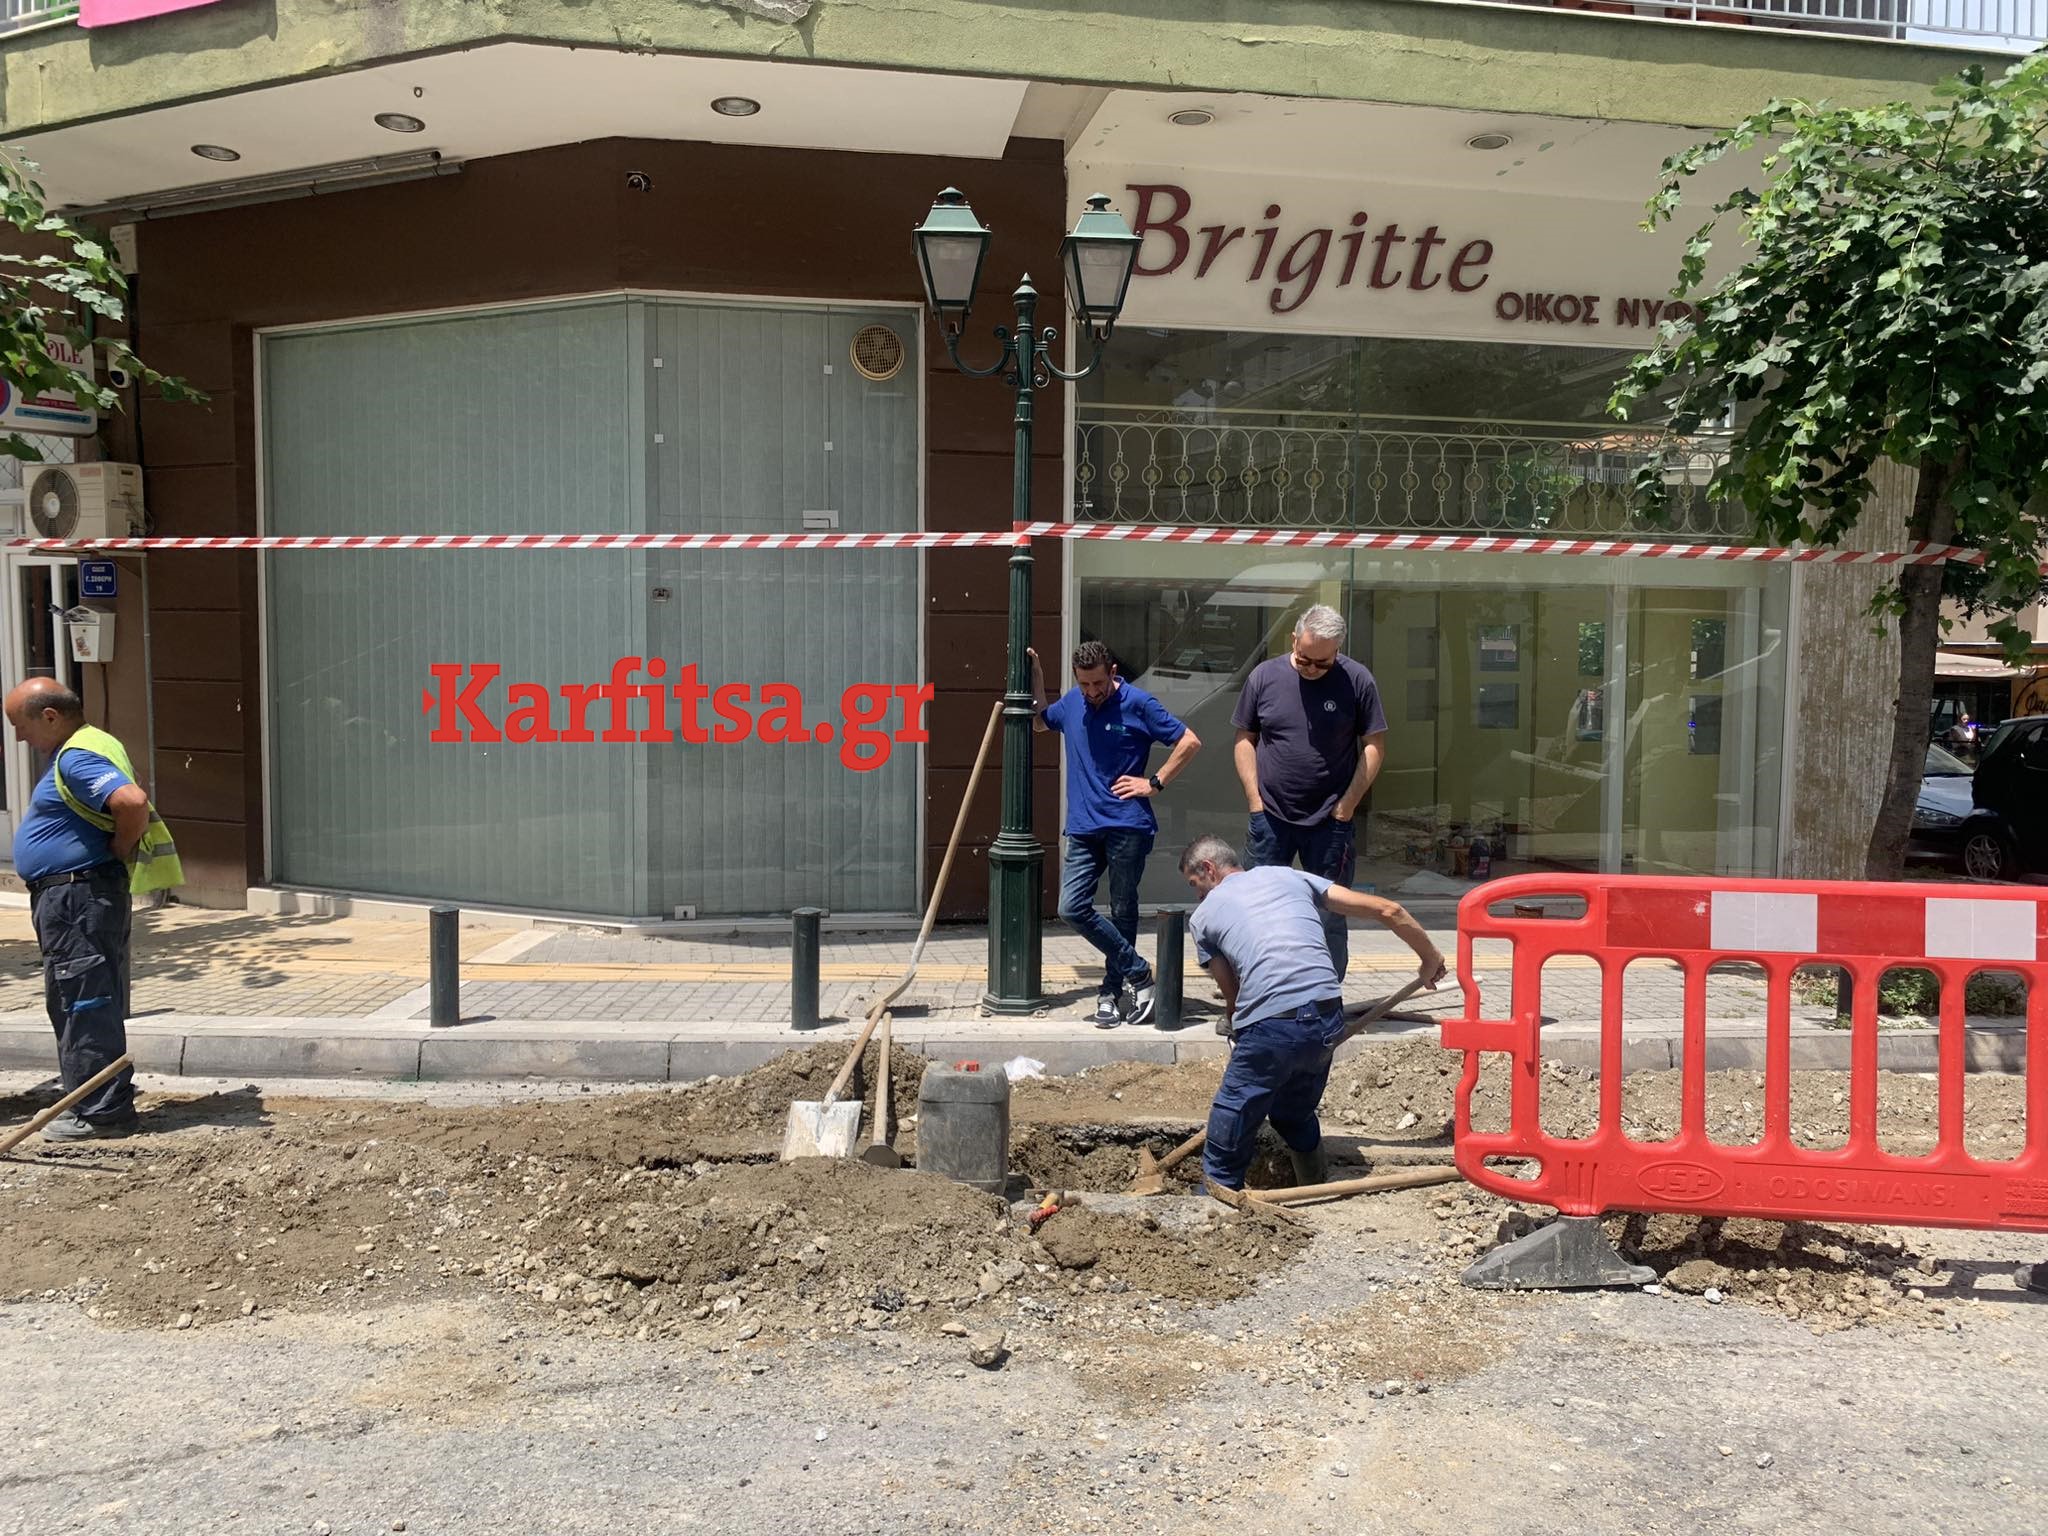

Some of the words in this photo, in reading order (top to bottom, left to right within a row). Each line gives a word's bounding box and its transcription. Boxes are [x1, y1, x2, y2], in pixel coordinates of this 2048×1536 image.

[1125, 183, 1494, 314] Brigitte
[1497, 291, 1600, 325] ΟΙΚΟΣ
[1616, 297, 1704, 331] ΝΥΦ
[1648, 1168, 1713, 1195] JSP
